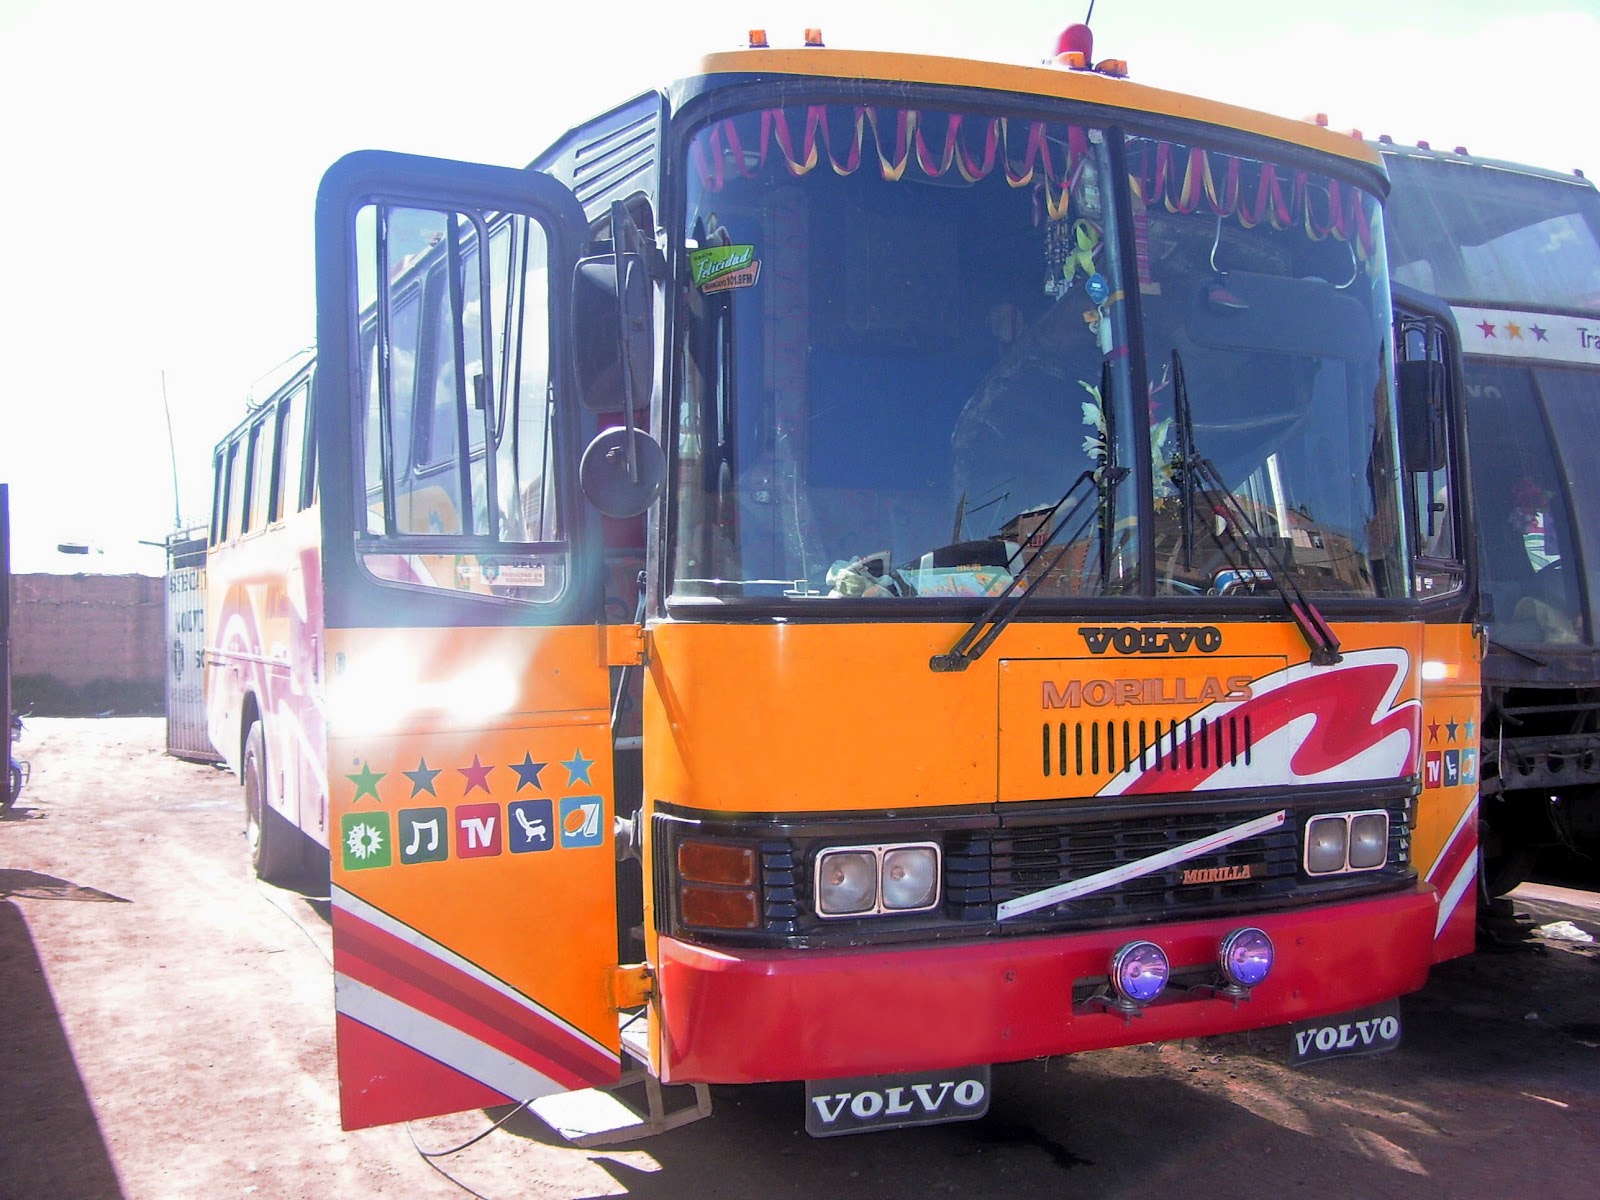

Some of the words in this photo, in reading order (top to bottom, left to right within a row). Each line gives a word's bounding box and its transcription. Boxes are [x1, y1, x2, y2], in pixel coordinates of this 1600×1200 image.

[695, 248, 751, 285] Felicidad
[1078, 626, 1222, 654] VOLVO
[1042, 676, 1253, 709] MORILLAS
[1427, 761, 1440, 782] TV
[461, 817, 495, 848] TV
[1182, 864, 1251, 885] MORILLA
[1295, 1015, 1399, 1055] VOLVO
[812, 1079, 985, 1123] VOLVO
